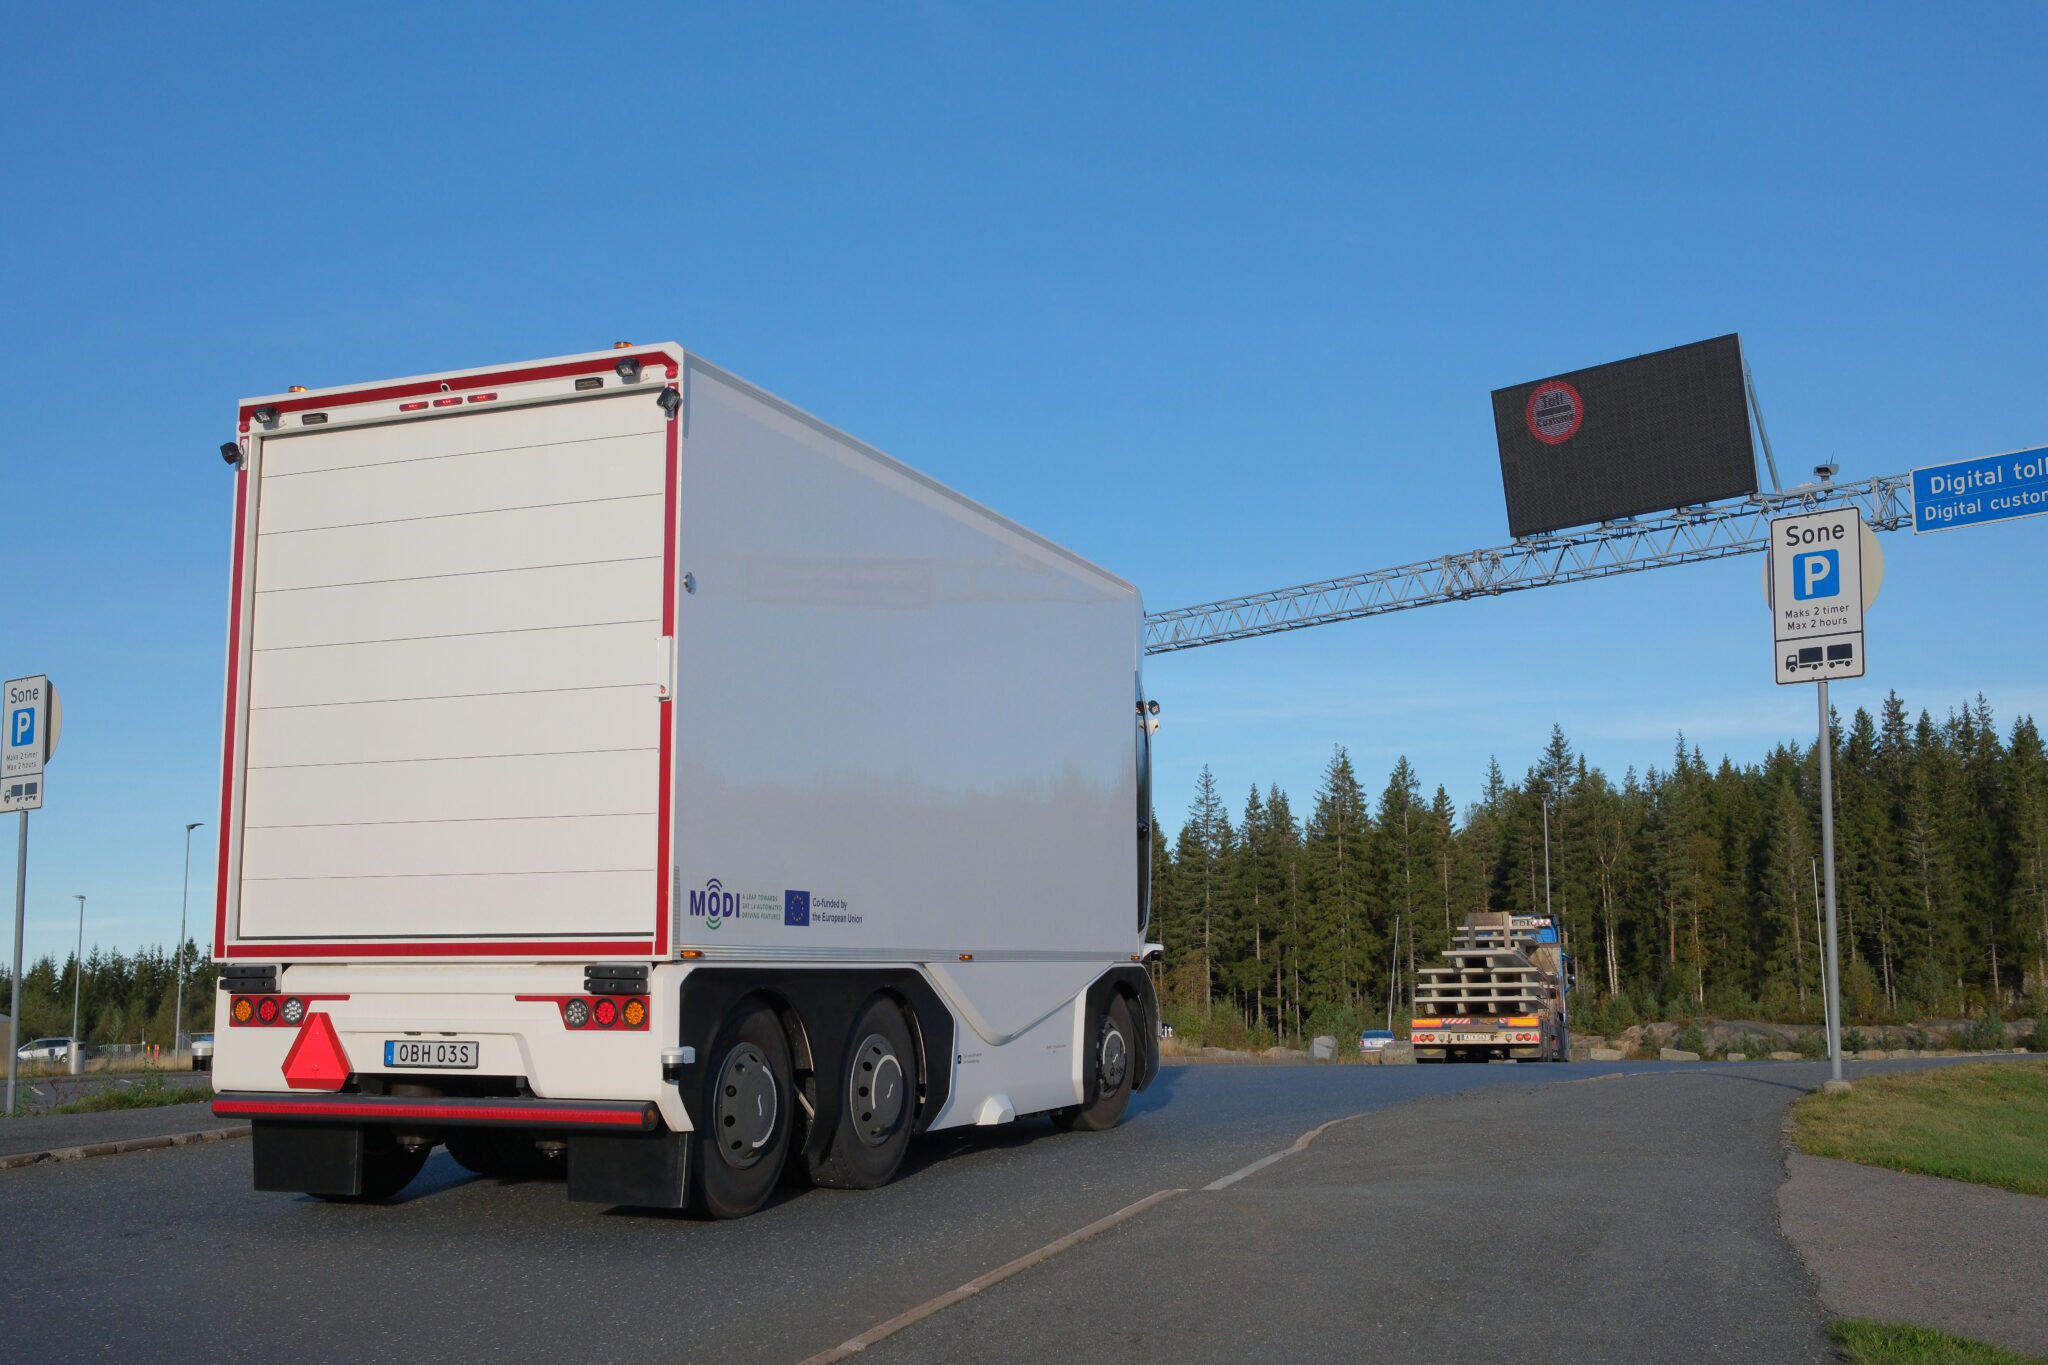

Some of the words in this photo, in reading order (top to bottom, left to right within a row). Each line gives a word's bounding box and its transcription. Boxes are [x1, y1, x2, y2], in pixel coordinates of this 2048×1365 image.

[1540, 392, 1563, 408] Toll
[1931, 465, 2002, 495] Digital
[1925, 498, 1981, 522] Digital
[1785, 524, 1845, 547] Sone
[1804, 555, 1831, 596] P
[1785, 609, 1810, 619] Maks
[1813, 606, 1820, 616] 2
[1822, 605, 1850, 615] timer
[1787, 621, 1807, 631] Max
[1810, 619, 1817, 628] 2
[1819, 617, 1848, 627] hours
[10, 687, 39, 704] Sone
[16, 711, 31, 744] P
[690, 890, 740, 918] MODI
[812, 897, 839, 909] Co-funded
[840, 899, 848, 911] by
[812, 912, 821, 922] the
[822, 912, 847, 925] European
[847, 913, 863, 923] Union
[400, 1044, 431, 1063] OBH
[437, 1045, 469, 1063] 03S
